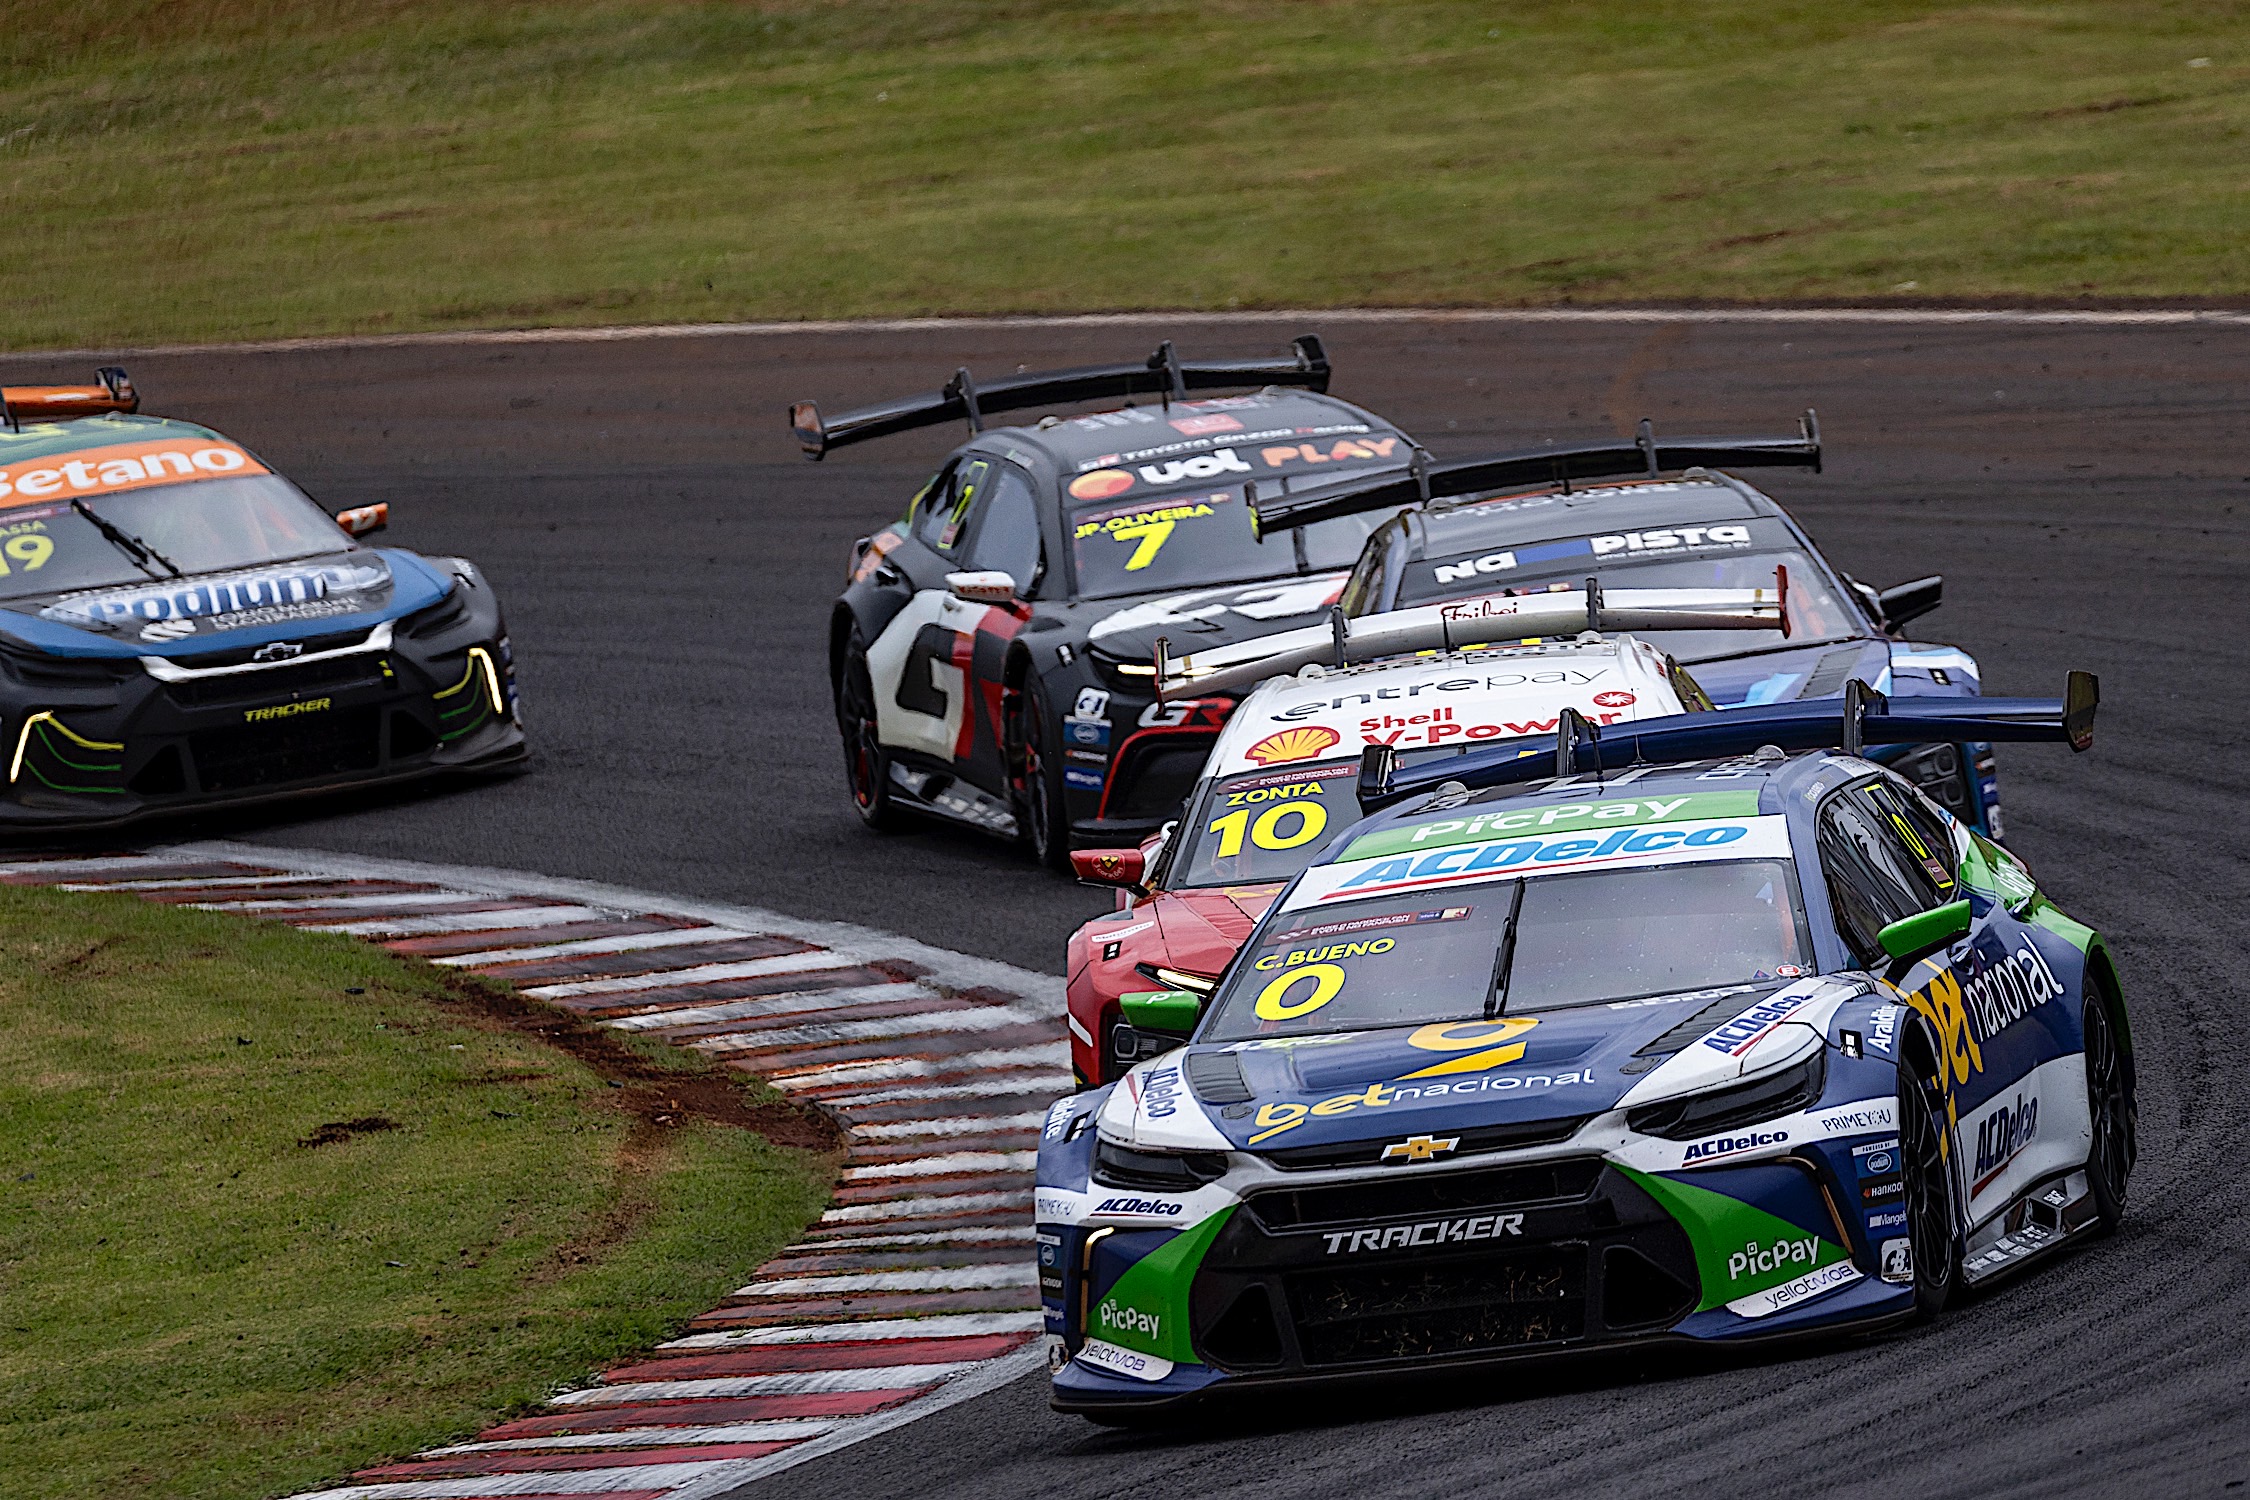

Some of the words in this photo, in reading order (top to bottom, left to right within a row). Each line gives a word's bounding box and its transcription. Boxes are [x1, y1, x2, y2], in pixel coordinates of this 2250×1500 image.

[0, 448, 245, 499] etano
[1260, 437, 1398, 468] PLAY
[1073, 504, 1215, 539] JP.OLIVEIRA
[1112, 520, 1176, 571] 7
[243, 697, 331, 723] TRACKER
[1270, 666, 1610, 722] entrepay
[1360, 707, 1453, 732] Shell
[1361, 712, 1622, 746] V-Powr
[1226, 781, 1324, 807] ZONTA
[1209, 800, 1328, 858] 10
[1410, 797, 1693, 843] PicPay
[1337, 826, 1748, 889] ACDelco
[1254, 937, 1396, 971] C.BUENO
[1703, 994, 1814, 1054] ACDelco
[1867, 1003, 1900, 1054] Araldite
[1142, 1066, 1183, 1119] ACDelco
[1248, 1068, 1595, 1145] betnacional
[1683, 1129, 1789, 1161] ACDelco
[1973, 1092, 2038, 1182] ACDelco
[1095, 1198, 1183, 1216] ACDelco
[1322, 1212, 1525, 1255] TRACKER
[1728, 1236, 1820, 1280] PicPay
[1100, 1298, 1161, 1341] PicPay
